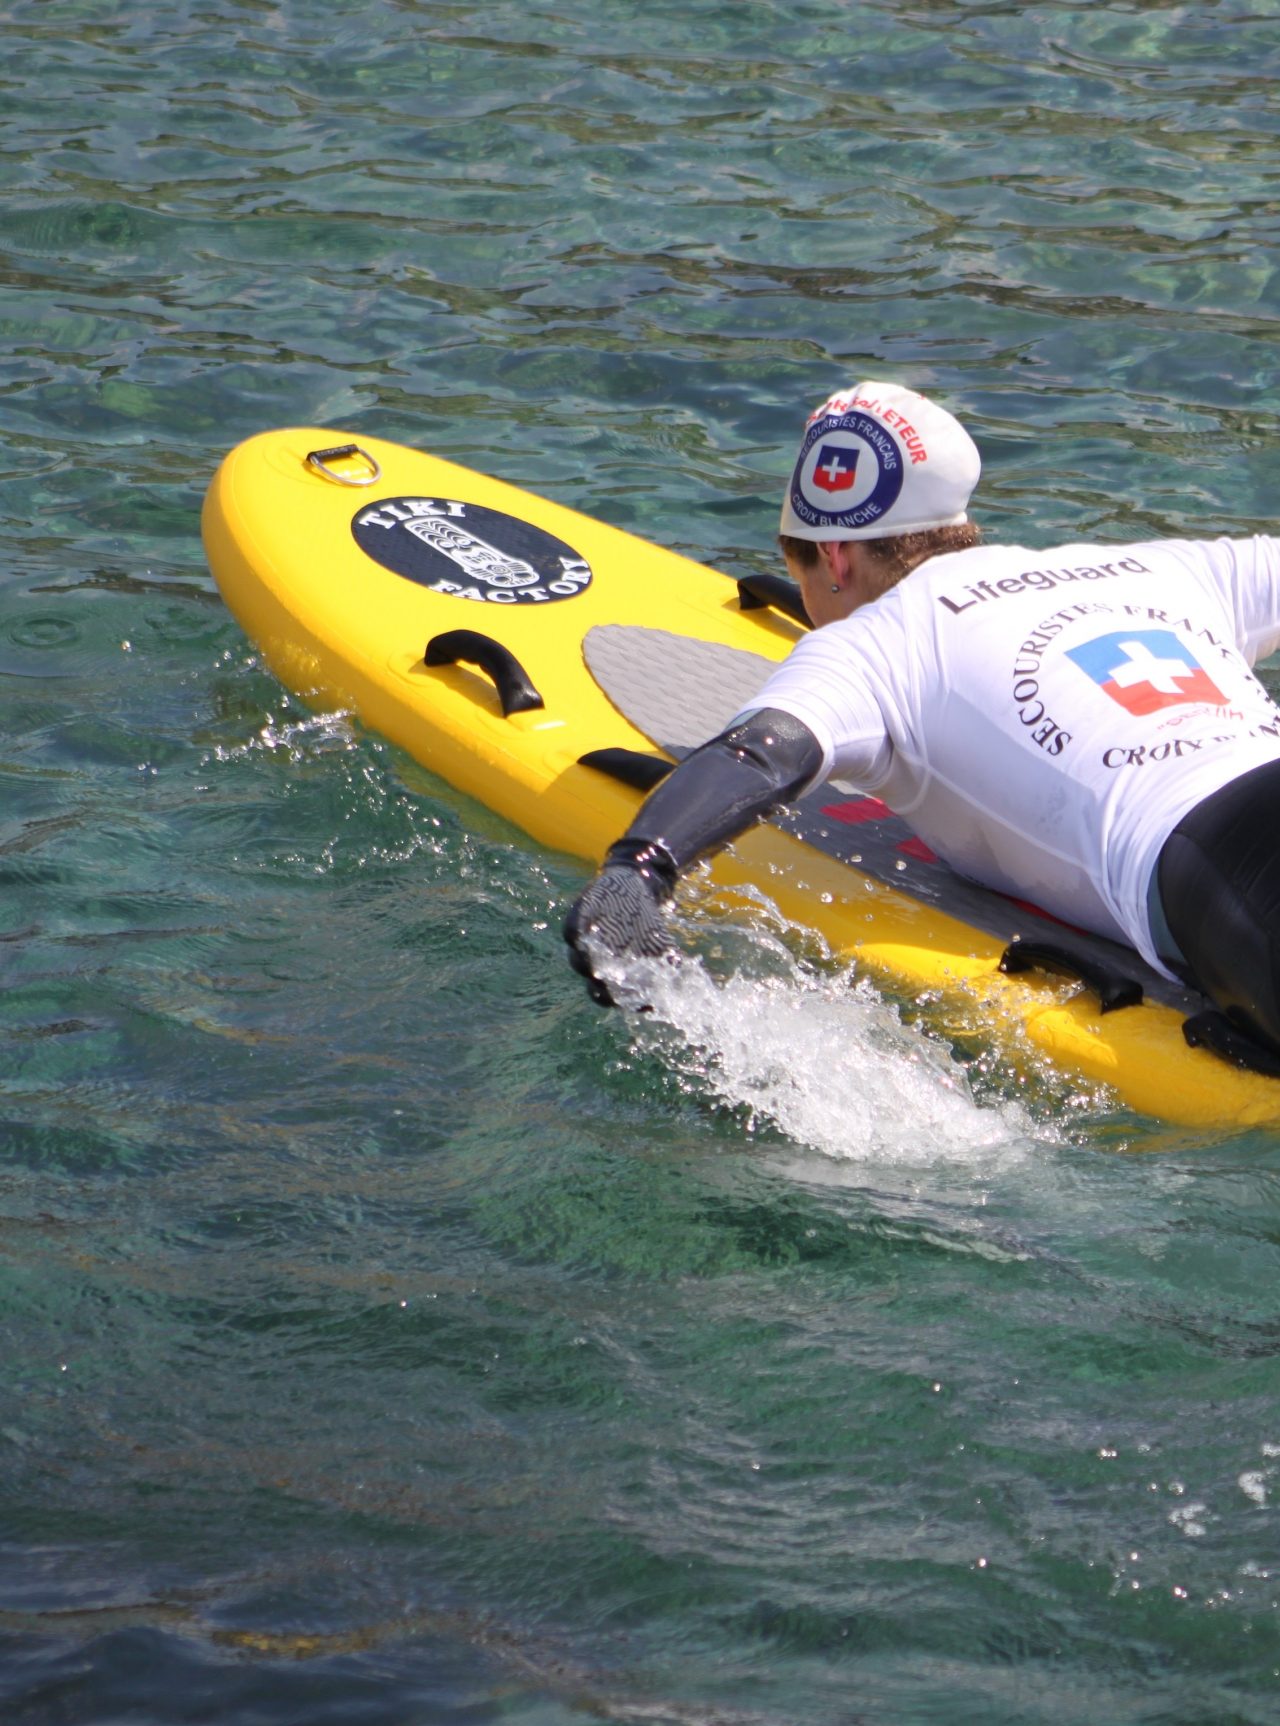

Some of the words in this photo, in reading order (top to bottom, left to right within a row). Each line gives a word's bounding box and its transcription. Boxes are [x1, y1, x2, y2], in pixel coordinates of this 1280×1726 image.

[852, 398, 928, 465] ETEUR
[857, 420, 897, 470] FRANCAIS
[359, 500, 466, 530] TIKI
[793, 494, 818, 525] CROIX
[820, 502, 882, 528] BLANCHE
[429, 556, 592, 603] FACTORY
[937, 557, 1152, 615] Lifeguard
[1013, 603, 1115, 757] SECOURISTES
